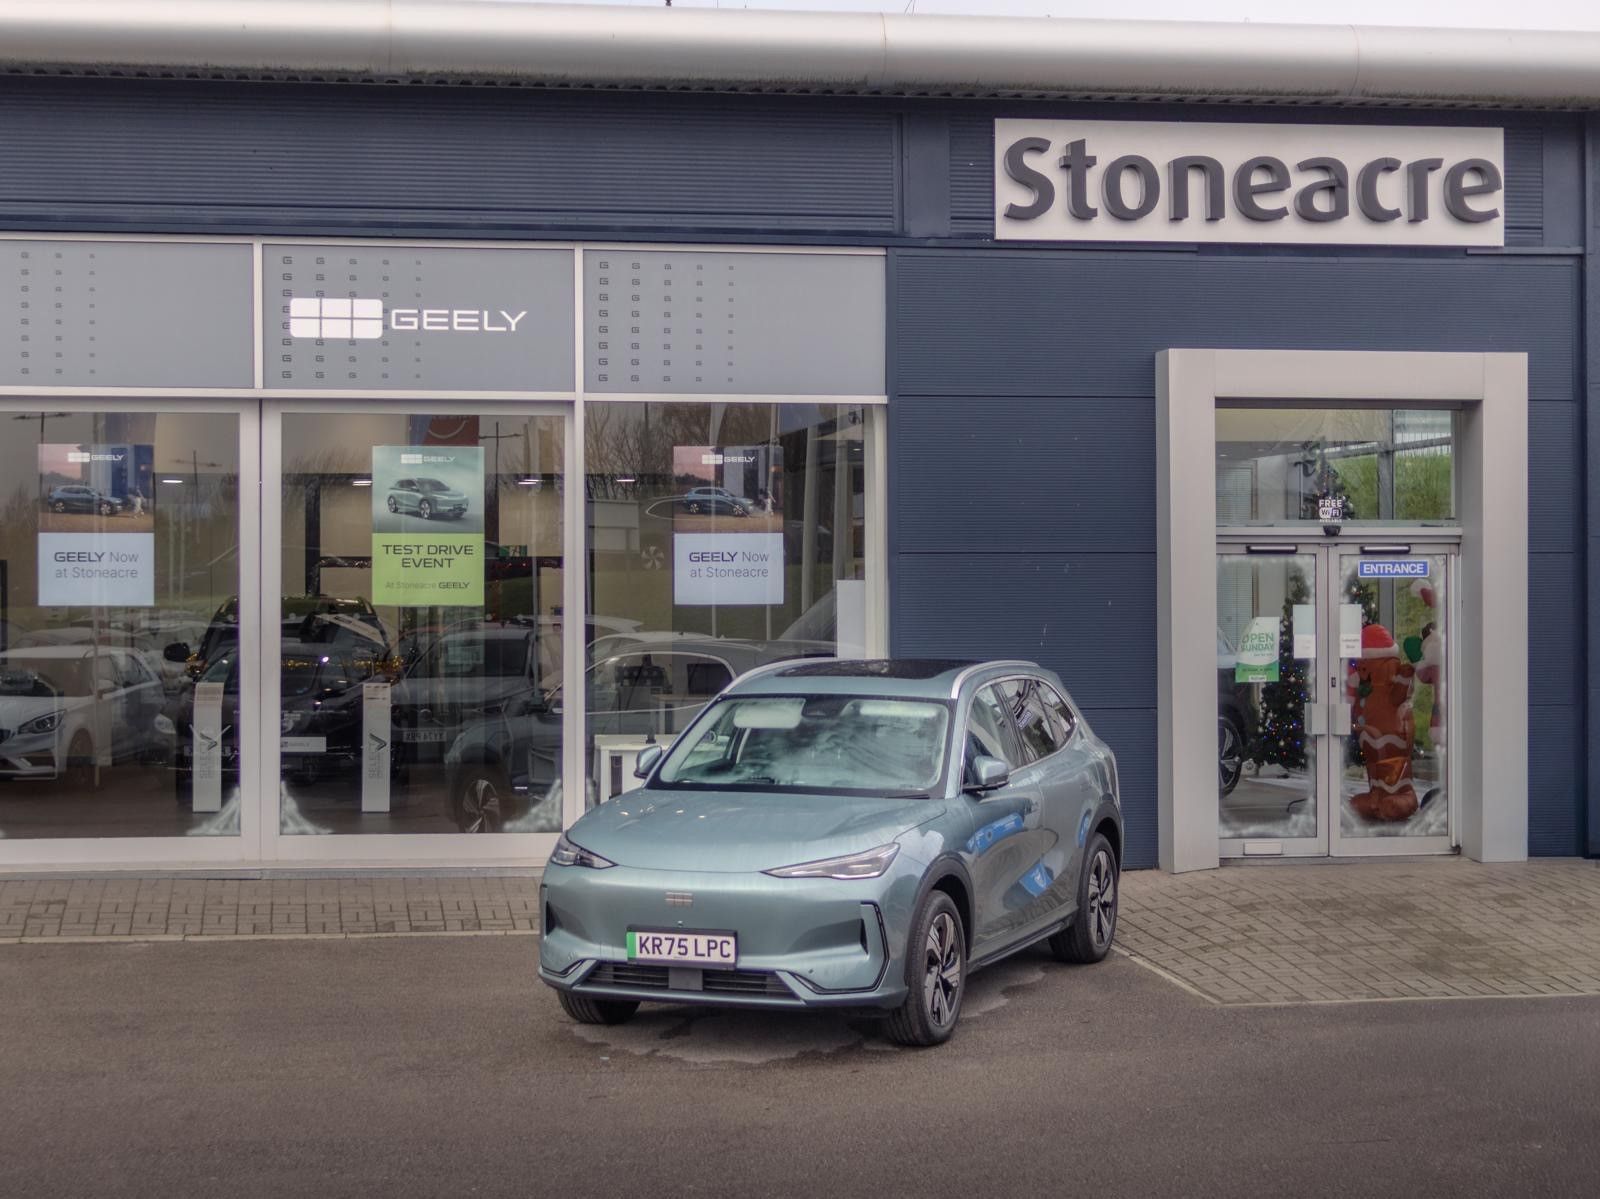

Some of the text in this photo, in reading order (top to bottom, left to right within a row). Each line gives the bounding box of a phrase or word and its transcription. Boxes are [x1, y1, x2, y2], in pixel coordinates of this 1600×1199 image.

[1004, 136, 1503, 224] Stoneacre
[391, 309, 528, 331] GEELY
[1319, 500, 1342, 508] FREE
[382, 545, 474, 555] TEST DRIVE
[54, 552, 139, 563] GEELY Now
[689, 552, 769, 562] GEELY Now
[402, 558, 455, 568] EVENT
[1363, 563, 1425, 574] ENTRANCE
[55, 567, 138, 578] at Stoneacre
[690, 567, 769, 578] at Stoneacre
[1242, 632, 1275, 643] OPEN
[1240, 643, 1275, 652] SUNDAY
[639, 936, 731, 958] KR75 LPC
